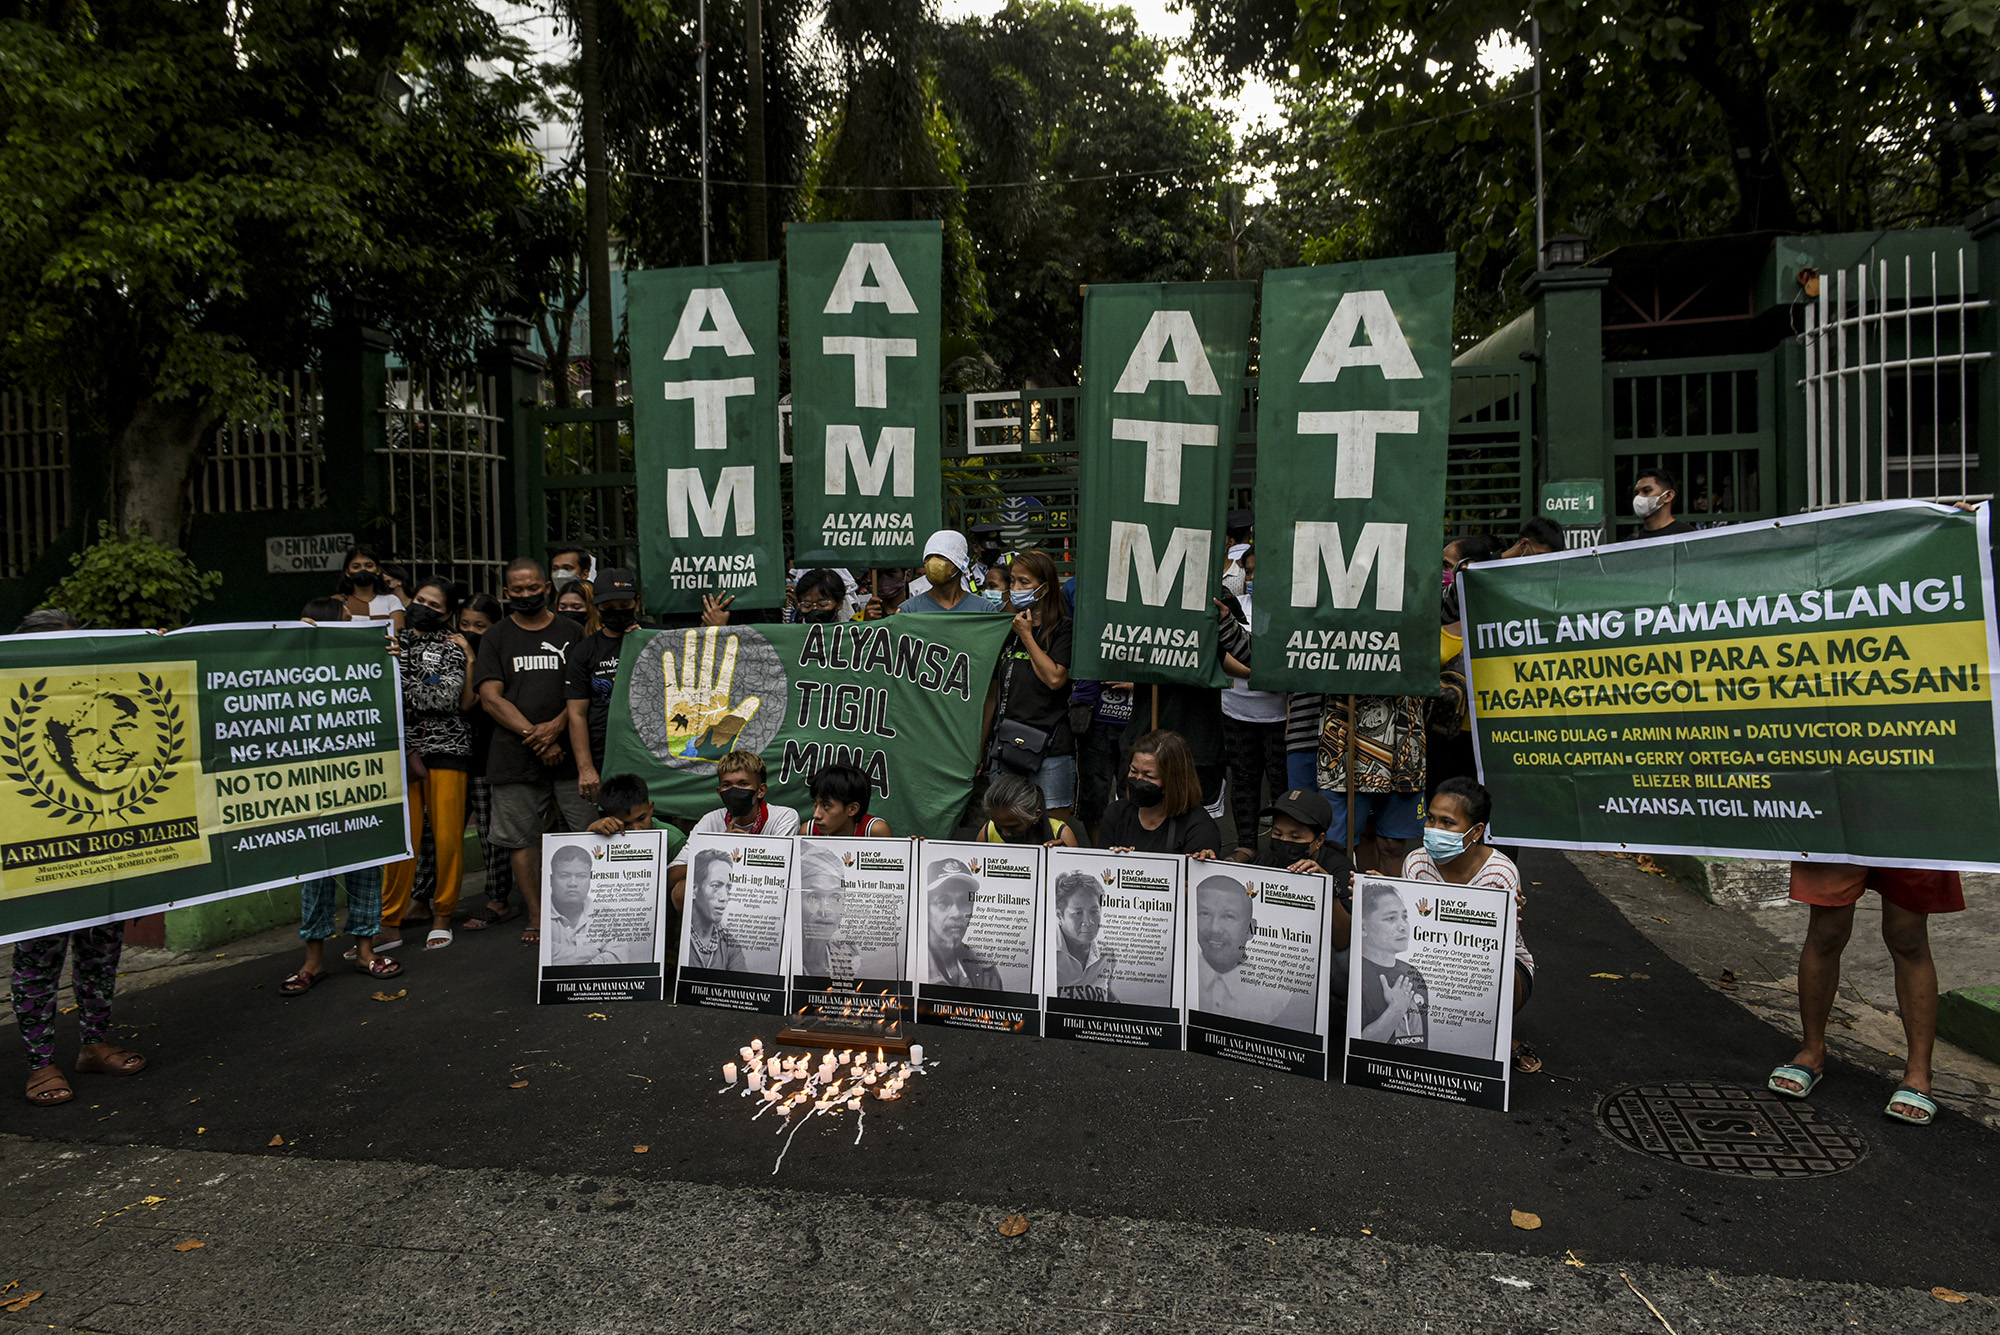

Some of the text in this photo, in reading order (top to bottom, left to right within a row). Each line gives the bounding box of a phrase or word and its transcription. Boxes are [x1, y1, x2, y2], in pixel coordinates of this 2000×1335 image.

[1546, 496, 1594, 510] GATE 1
[822, 513, 914, 529] ALYANSA
[822, 531, 915, 546] TIGIL MINA
[1563, 528, 1604, 549] NTRY
[292, 556, 329, 569] ONLY
[670, 554, 755, 573] ALYANSA
[671, 572, 757, 590] TIGIL MINA
[1477, 575, 1966, 649] ITIGIL ANG PAMAMASLANG!
[1100, 623, 1199, 648] ALYANSA
[1286, 631, 1400, 651] ALYANSA
[513, 655, 558, 672] PUMA
[799, 623, 970, 701] ALYANSA
[1099, 642, 1199, 668] TIGIL MINA
[1285, 651, 1401, 672] TIGIL MINA
[1514, 635, 1910, 682] KATARUNGAN PARA SA MGA
[207, 663, 382, 689] IPAGTANGGOL ANG
[1478, 664, 1980, 710] TAGAPAGTANGGOL NG KALIKASAN!
[224, 687, 372, 714] GUNITA NG MGA
[795, 681, 897, 738] TIGIL
[215, 708, 382, 739] BAYANI AT MARTIR
[1492, 720, 1956, 743] MACLI-ING DULAG ARMIN MARIN DATU VICTOR DANYAN
[230, 731, 376, 763] NG KALIKASAN!
[1513, 749, 1934, 765] GLORIA CAPITAN GERRY ORTEGA GENSUN AGUSTIN
[216, 758, 383, 797] NO TO MINING IN
[1632, 774, 1771, 789] ELIEZER BILLANES
[222, 782, 387, 824] SIBUYAN ISLAND!
[1599, 798, 1822, 819] -ALYANSA TIGIL MINA-
[5, 821, 197, 865] ARMIN RIOS MARIN
[232, 815, 383, 852] -ALYANSA TIGIL MINA-
[35, 869, 78, 883] SIBUYAN
[118, 857, 157, 869] ROMBLON
[159, 853, 179, 863] (2007)
[38, 860, 82, 874] Municipal
[128, 850, 143, 858] Shot
[590, 869, 651, 880] Gensun Agustin
[764, 875, 785, 888] Dulag
[841, 880, 905, 891] Datu Victor Danyan
[969, 892, 1030, 905] Eliezer Billanes
[1100, 894, 1172, 912] Gloria Capitan
[1247, 922, 1312, 944] Armin Marin
[1414, 926, 1498, 952] Gerry Ortega
[1413, 952, 1462, 961] pro-environment
[1433, 948, 1449, 956] Gerry
[1450, 950, 1470, 958] Ortega
[557, 981, 645, 992] ITIGIL ANG PAMAMASLANG!
[1064, 1018, 1162, 1037] ITIGIL ANG PAMAMASLANG!
[1205, 1033, 1305, 1063] ITIGIL ANG PAMAMASLANG!
[1368, 1063, 1482, 1092] ITIGIL ANG PAMAMASLANG!
[1389, 1079, 1422, 1089] KATARUNGAN
[1381, 1082, 1427, 1095] TAGAPAGTANGGOL
[1437, 1093, 1466, 1102] KALIKASAN!
